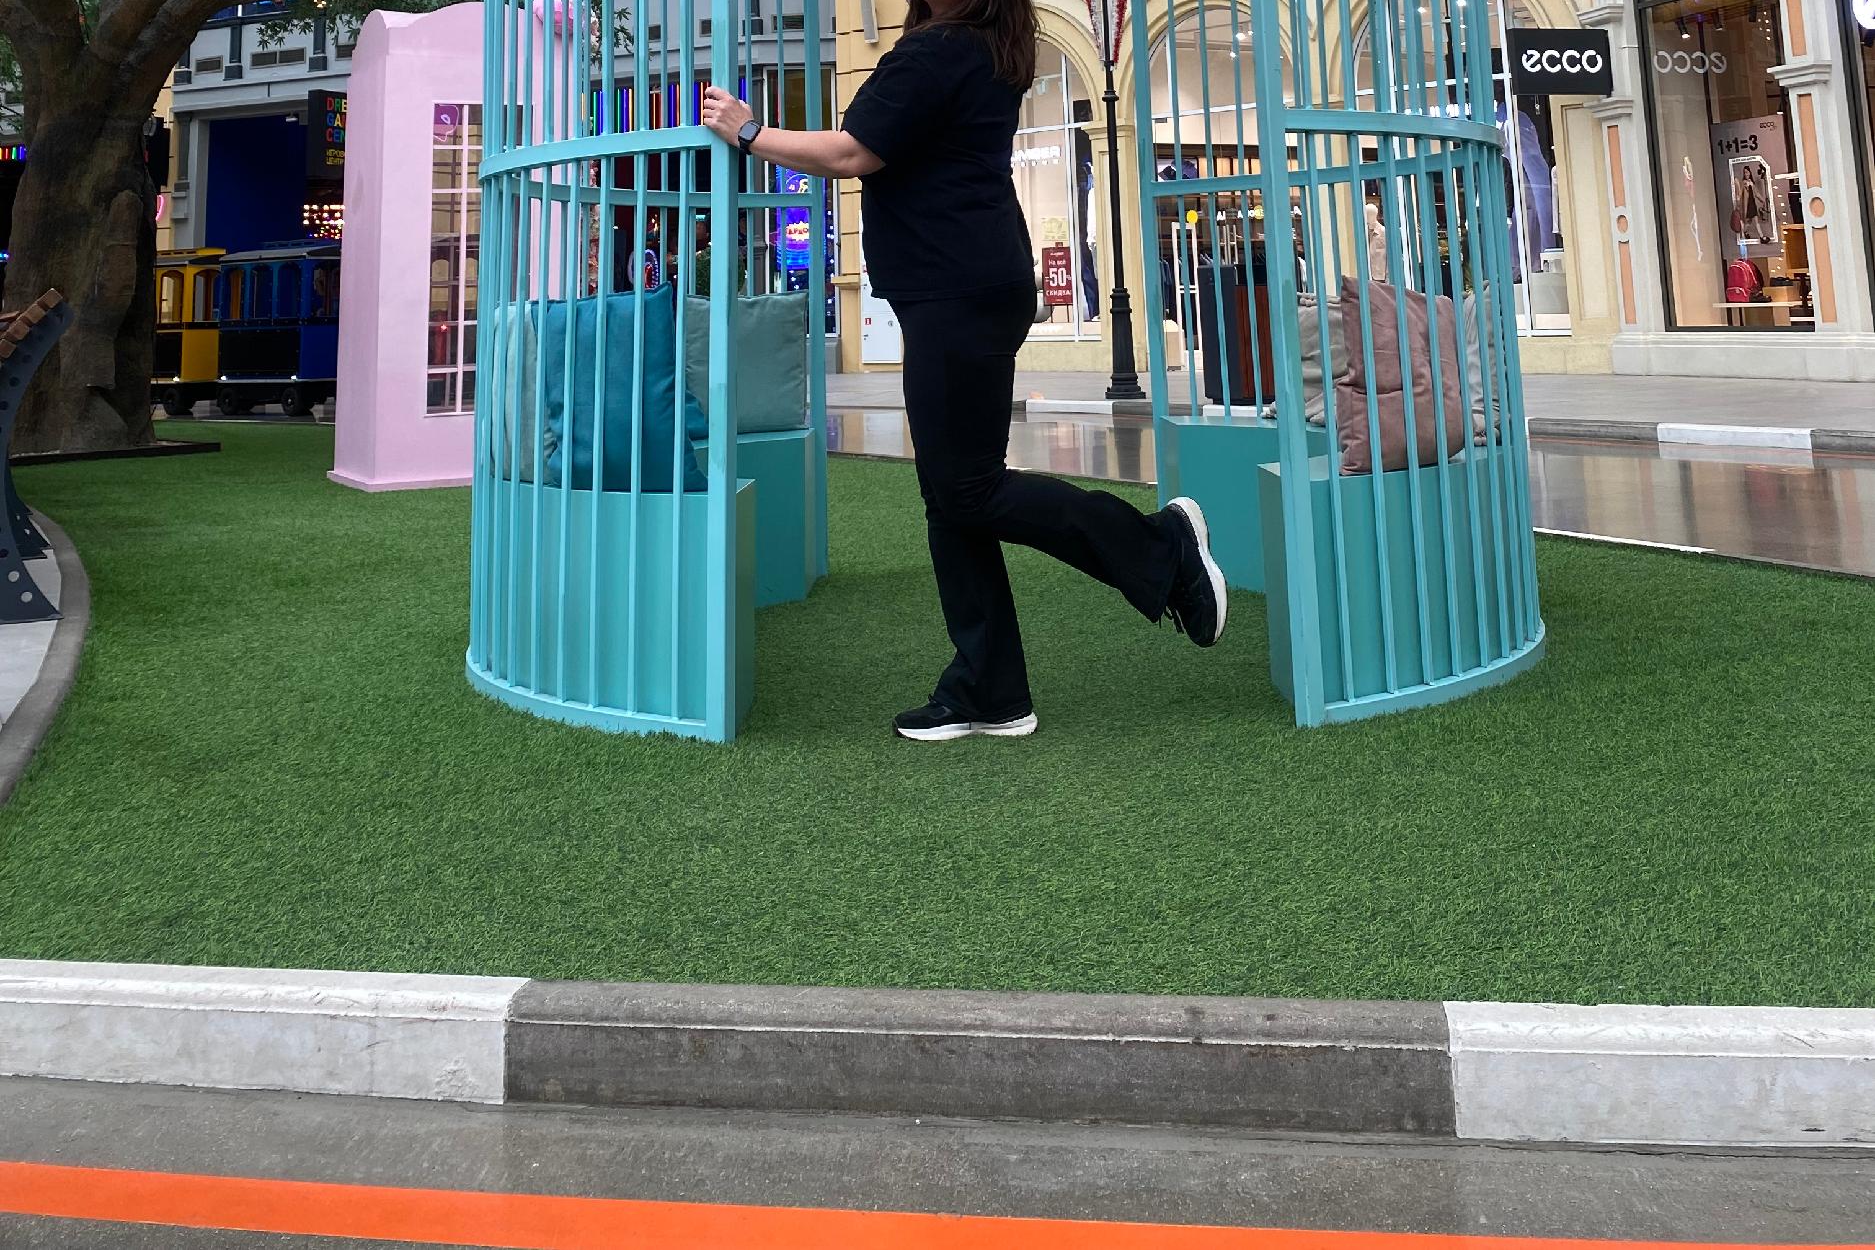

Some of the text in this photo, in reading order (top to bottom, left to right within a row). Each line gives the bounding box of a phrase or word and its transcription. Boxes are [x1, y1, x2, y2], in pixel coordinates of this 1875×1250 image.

[1522, 49, 1603, 73] ecco
[326, 98, 347, 112] DRE
[1718, 134, 1758, 154] 1+1=3
